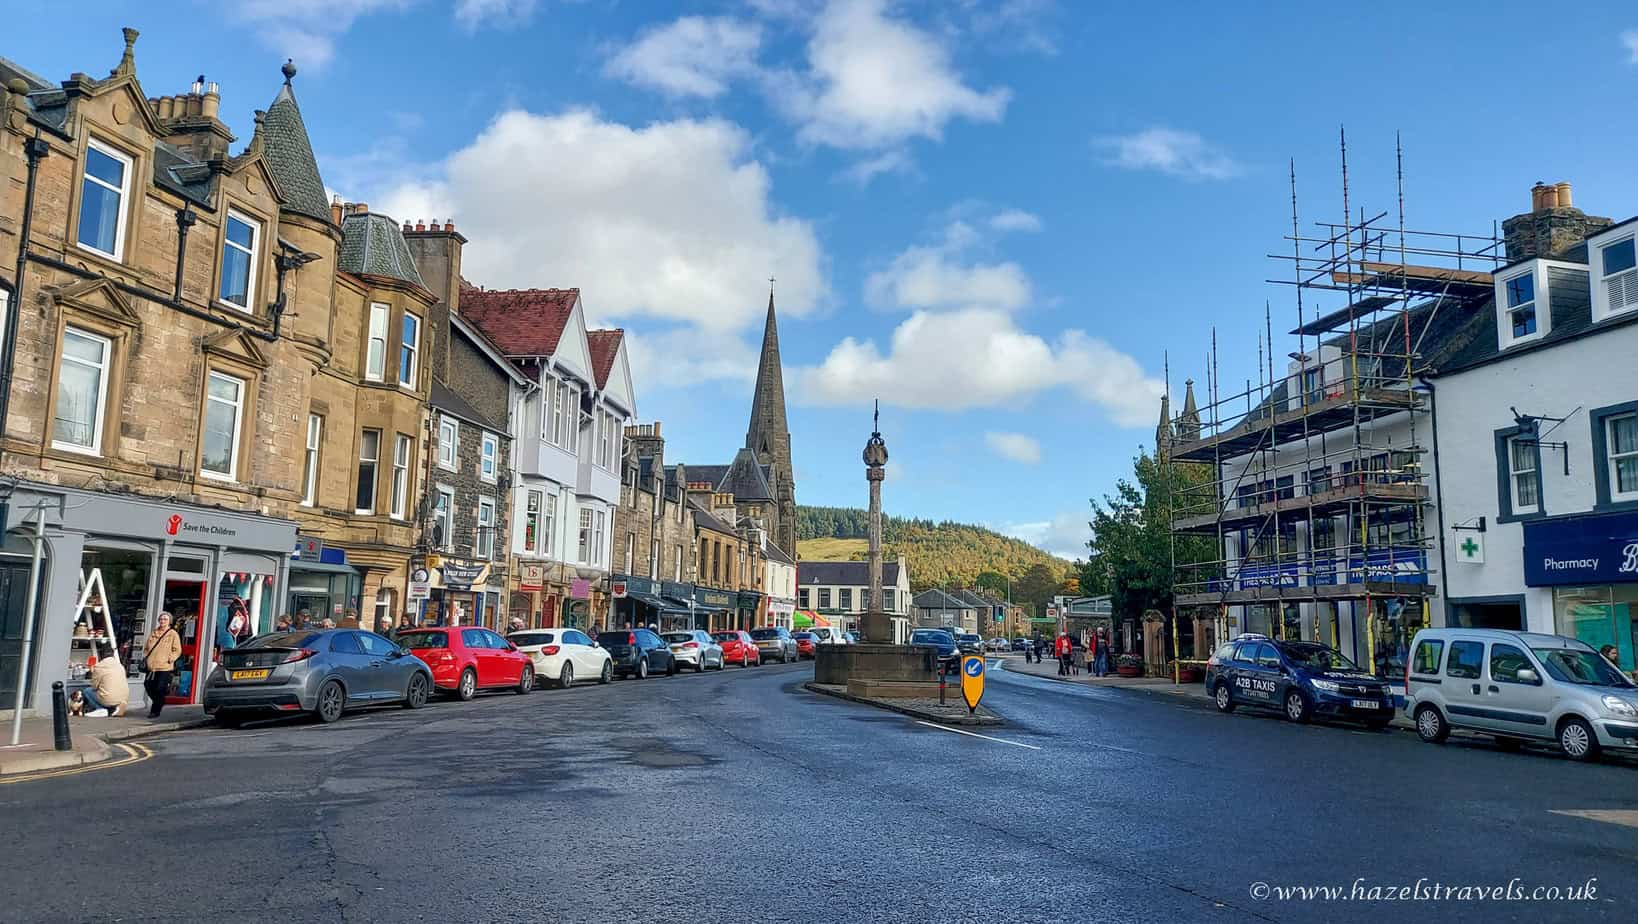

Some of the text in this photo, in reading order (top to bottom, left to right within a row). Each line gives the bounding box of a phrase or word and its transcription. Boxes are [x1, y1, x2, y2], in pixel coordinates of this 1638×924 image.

[183, 522, 236, 536] Save the Children
[1544, 557, 1599, 571] Pharmacy
[1236, 677, 1275, 692] A2B TAXIS
